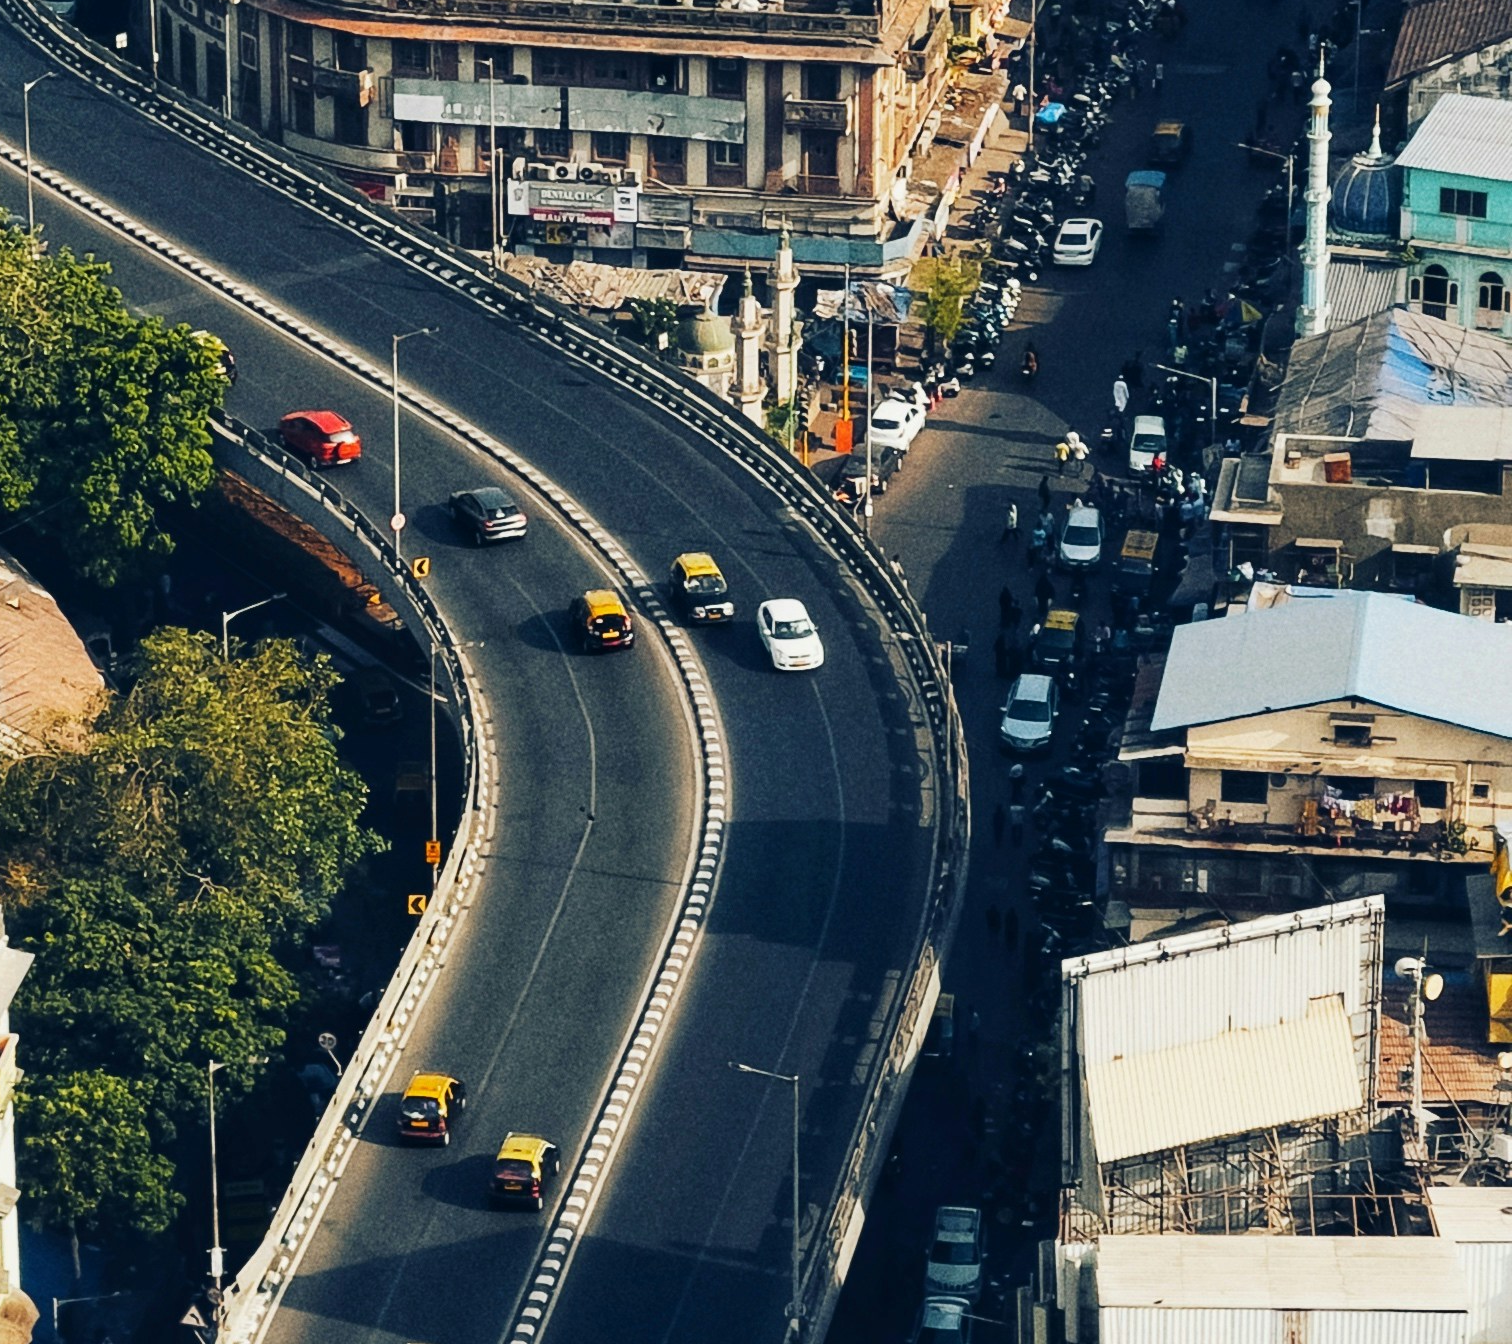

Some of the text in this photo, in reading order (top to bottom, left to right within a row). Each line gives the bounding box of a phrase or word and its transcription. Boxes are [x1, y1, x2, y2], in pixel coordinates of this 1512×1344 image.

[541, 189, 574, 200] DENTAL
[533, 213, 575, 224] BEAUTY
[576, 215, 612, 226] HOUSE
